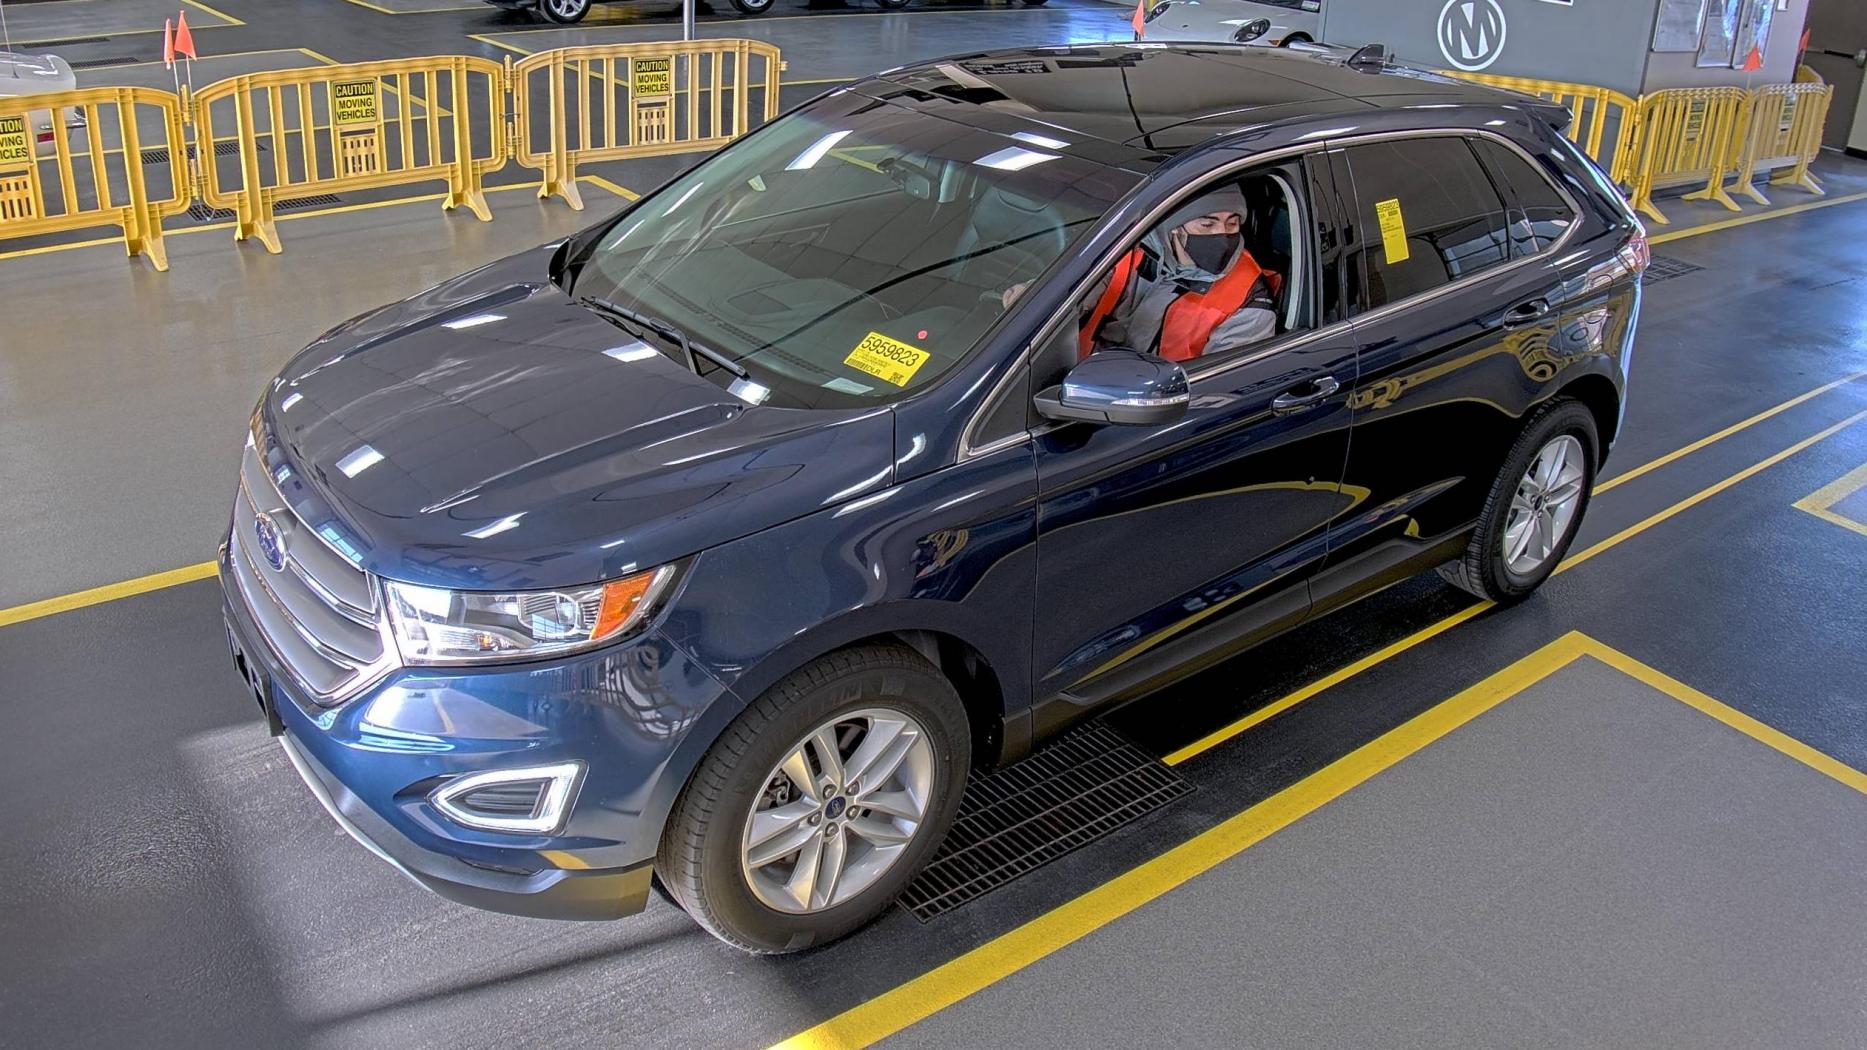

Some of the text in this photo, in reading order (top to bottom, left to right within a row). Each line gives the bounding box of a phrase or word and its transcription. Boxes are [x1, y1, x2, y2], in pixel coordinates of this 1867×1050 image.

[636, 61, 668, 72] CAUTION
[637, 73, 667, 84] MOVING
[336, 83, 374, 97] CAUTION
[635, 83, 669, 94] VEHICLES
[338, 97, 373, 109] MOVING
[337, 108, 376, 121] VEHICLES
[861, 336, 920, 367] 5959823
